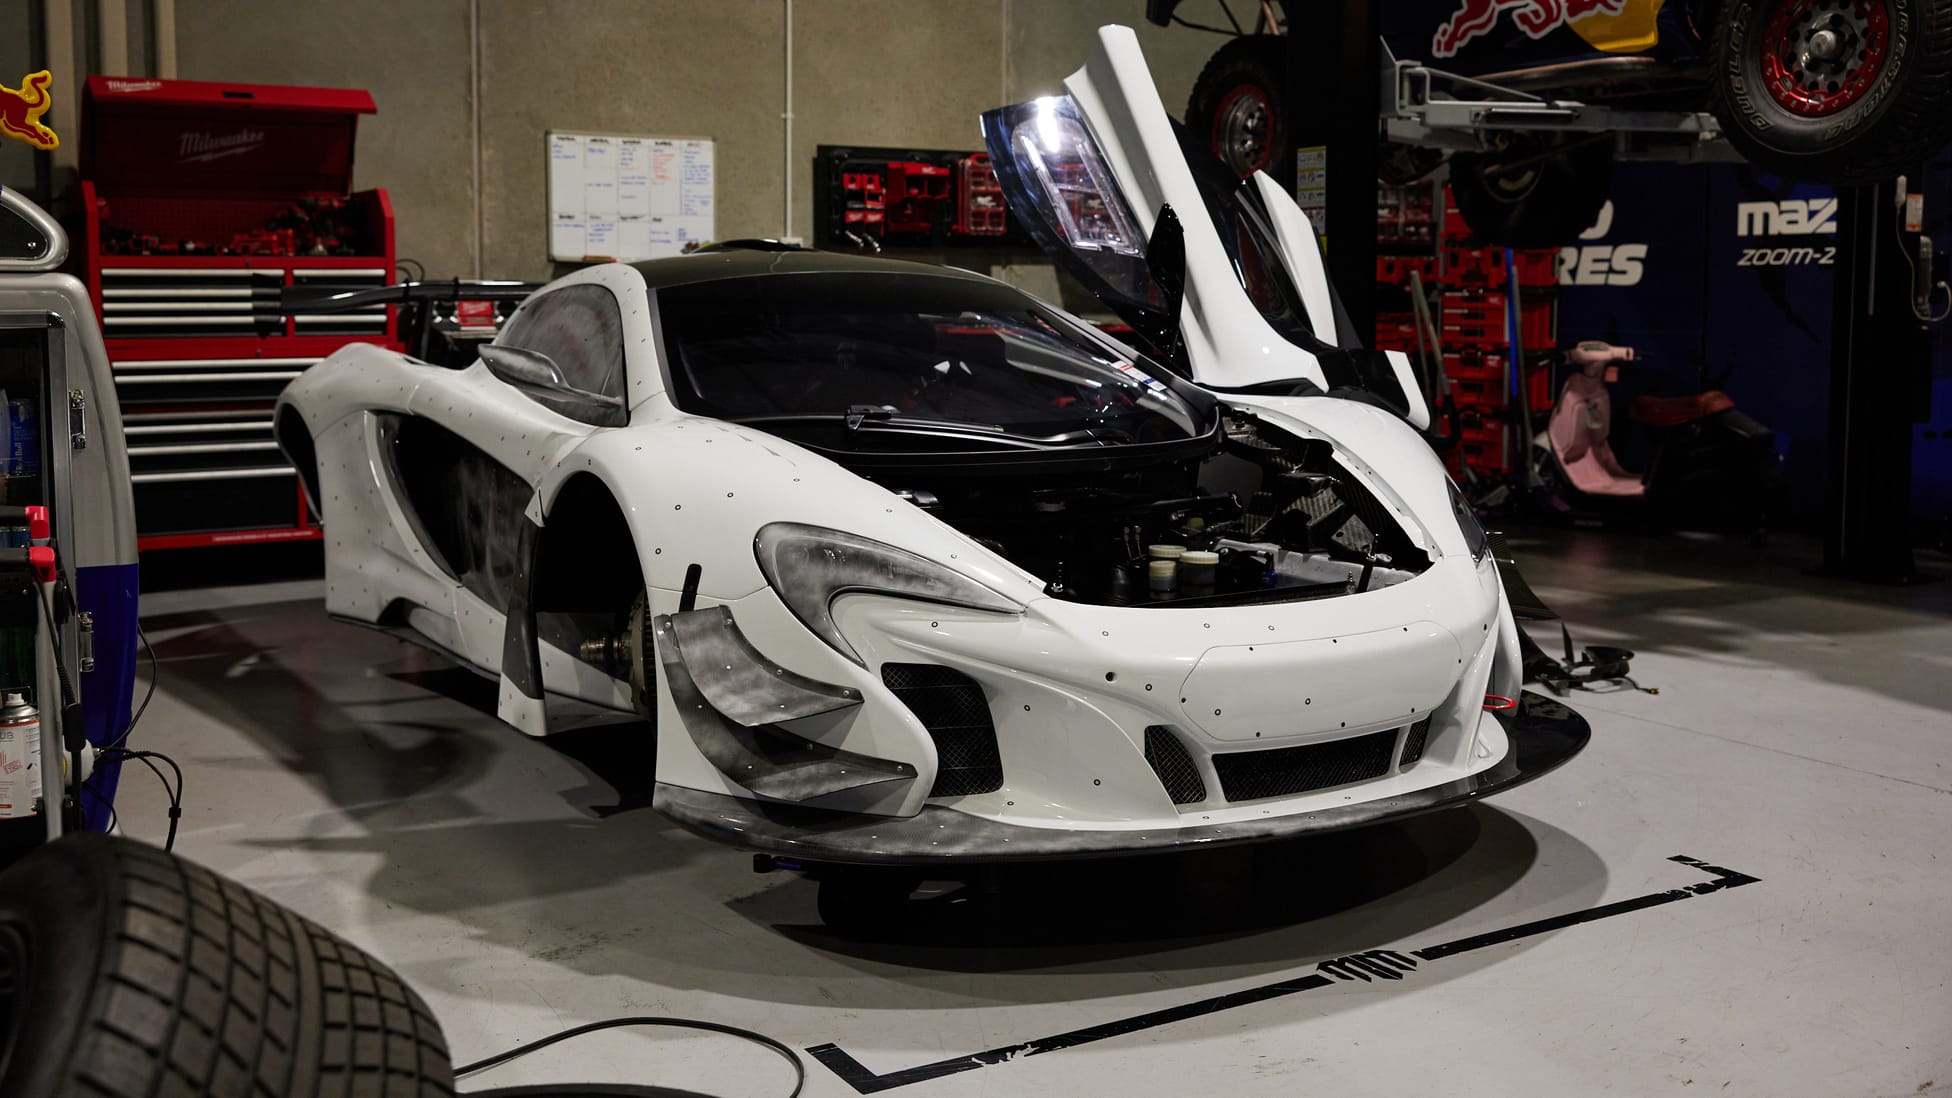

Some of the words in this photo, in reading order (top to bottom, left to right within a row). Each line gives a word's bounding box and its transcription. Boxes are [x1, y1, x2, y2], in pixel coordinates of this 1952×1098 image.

[177, 128, 264, 156] Milwaukee
[1737, 198, 1838, 236] maz
[1557, 243, 1648, 286] RES
